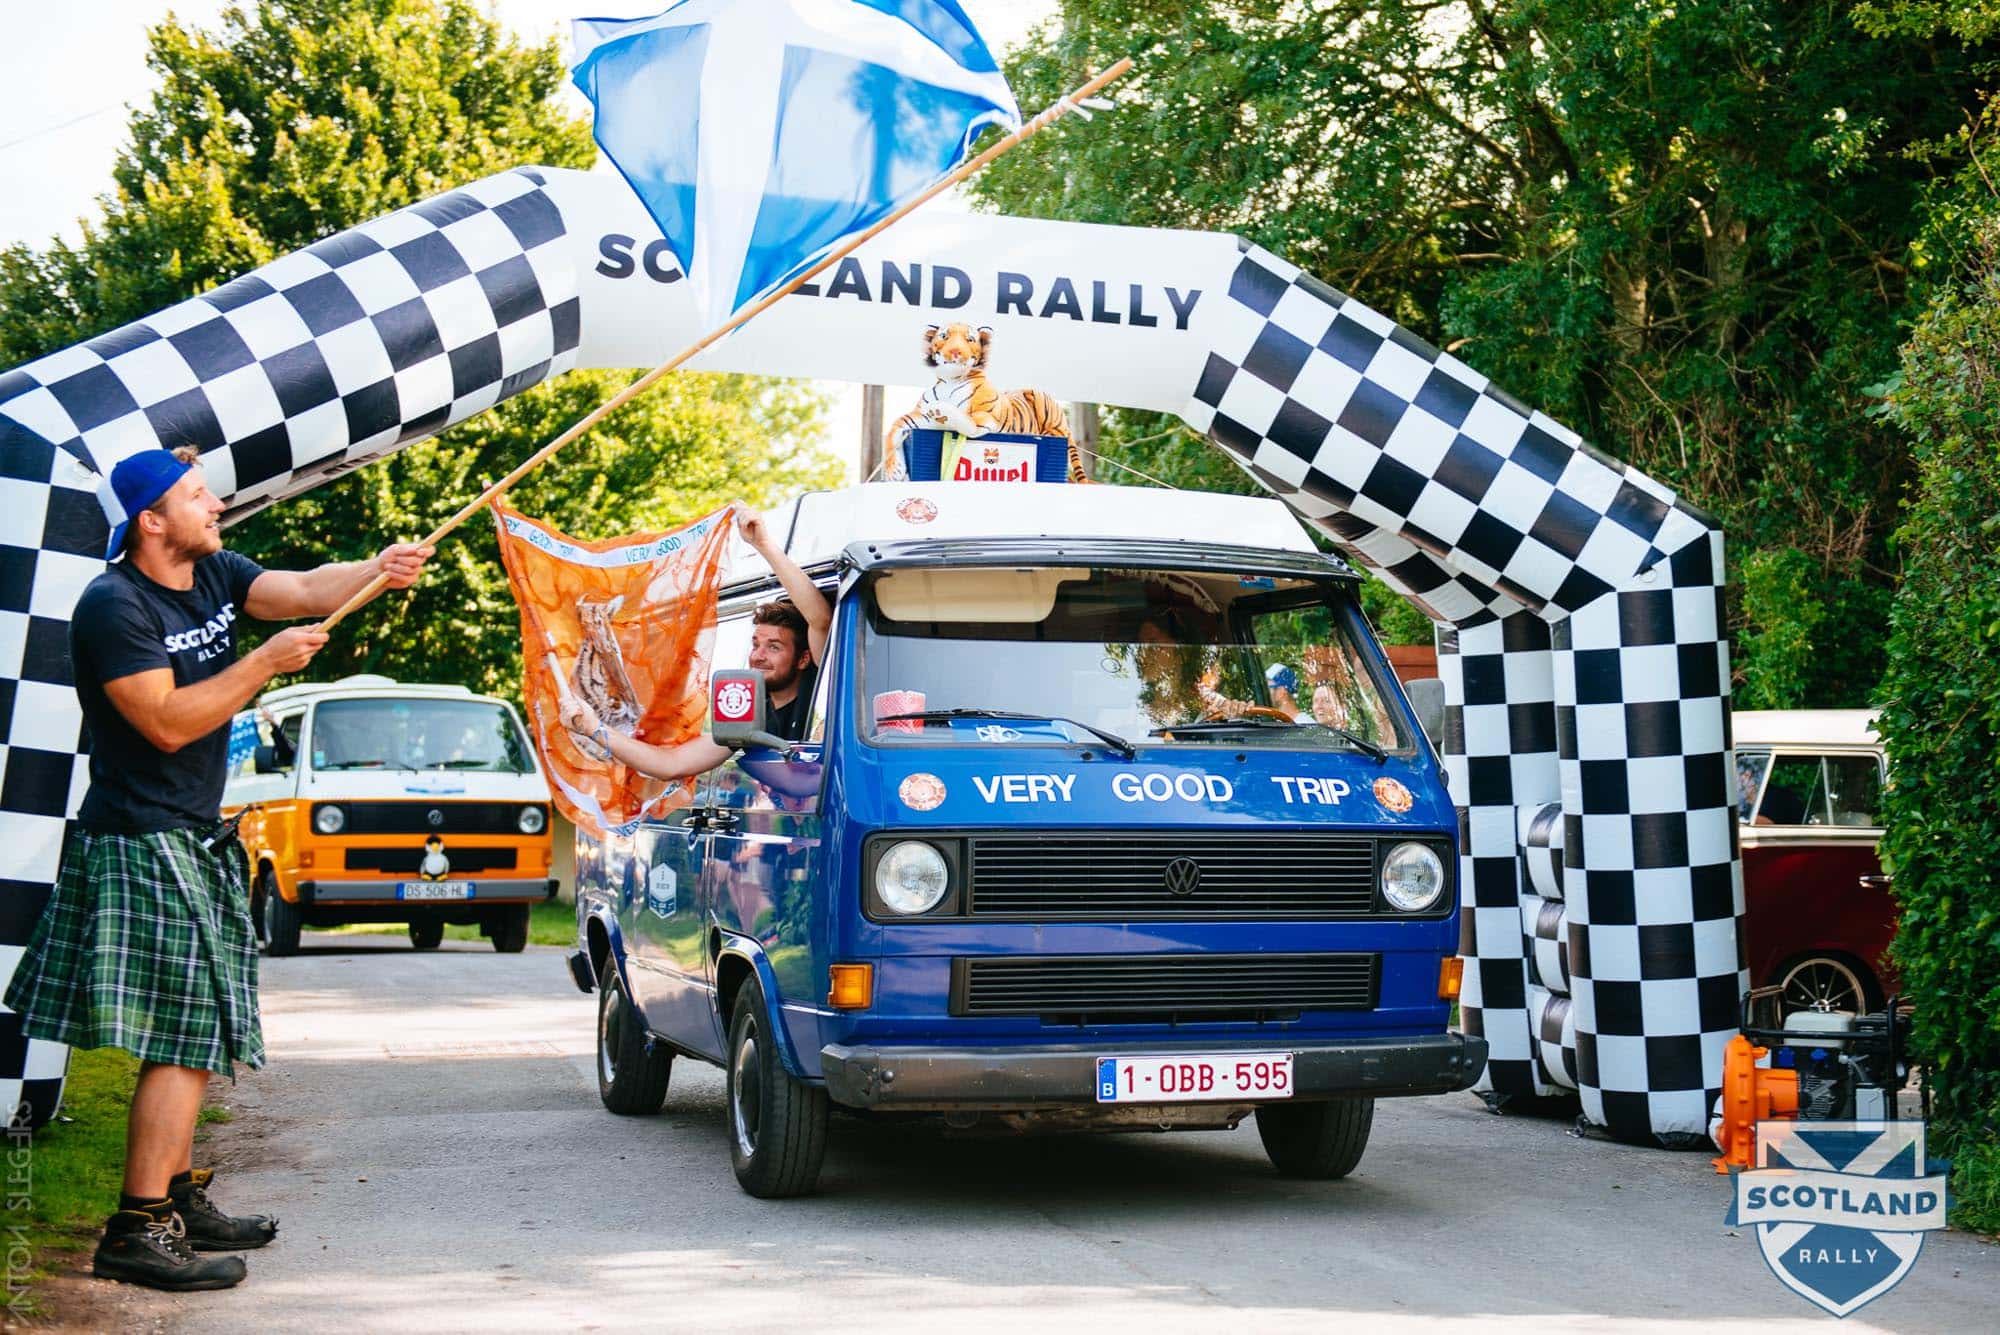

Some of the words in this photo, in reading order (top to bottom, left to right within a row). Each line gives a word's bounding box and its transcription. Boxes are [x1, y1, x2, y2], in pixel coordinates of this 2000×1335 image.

[594, 233, 973, 310] SCAND
[996, 271, 1203, 331] RALLY
[197, 636, 231, 662] ALLY
[972, 773, 1077, 804] VERY
[1111, 772, 1234, 803] GOOD
[1271, 776, 1351, 805] TRIP
[1103, 1083, 1114, 1097] B
[1123, 1061, 1288, 1094] 1-OBB-595
